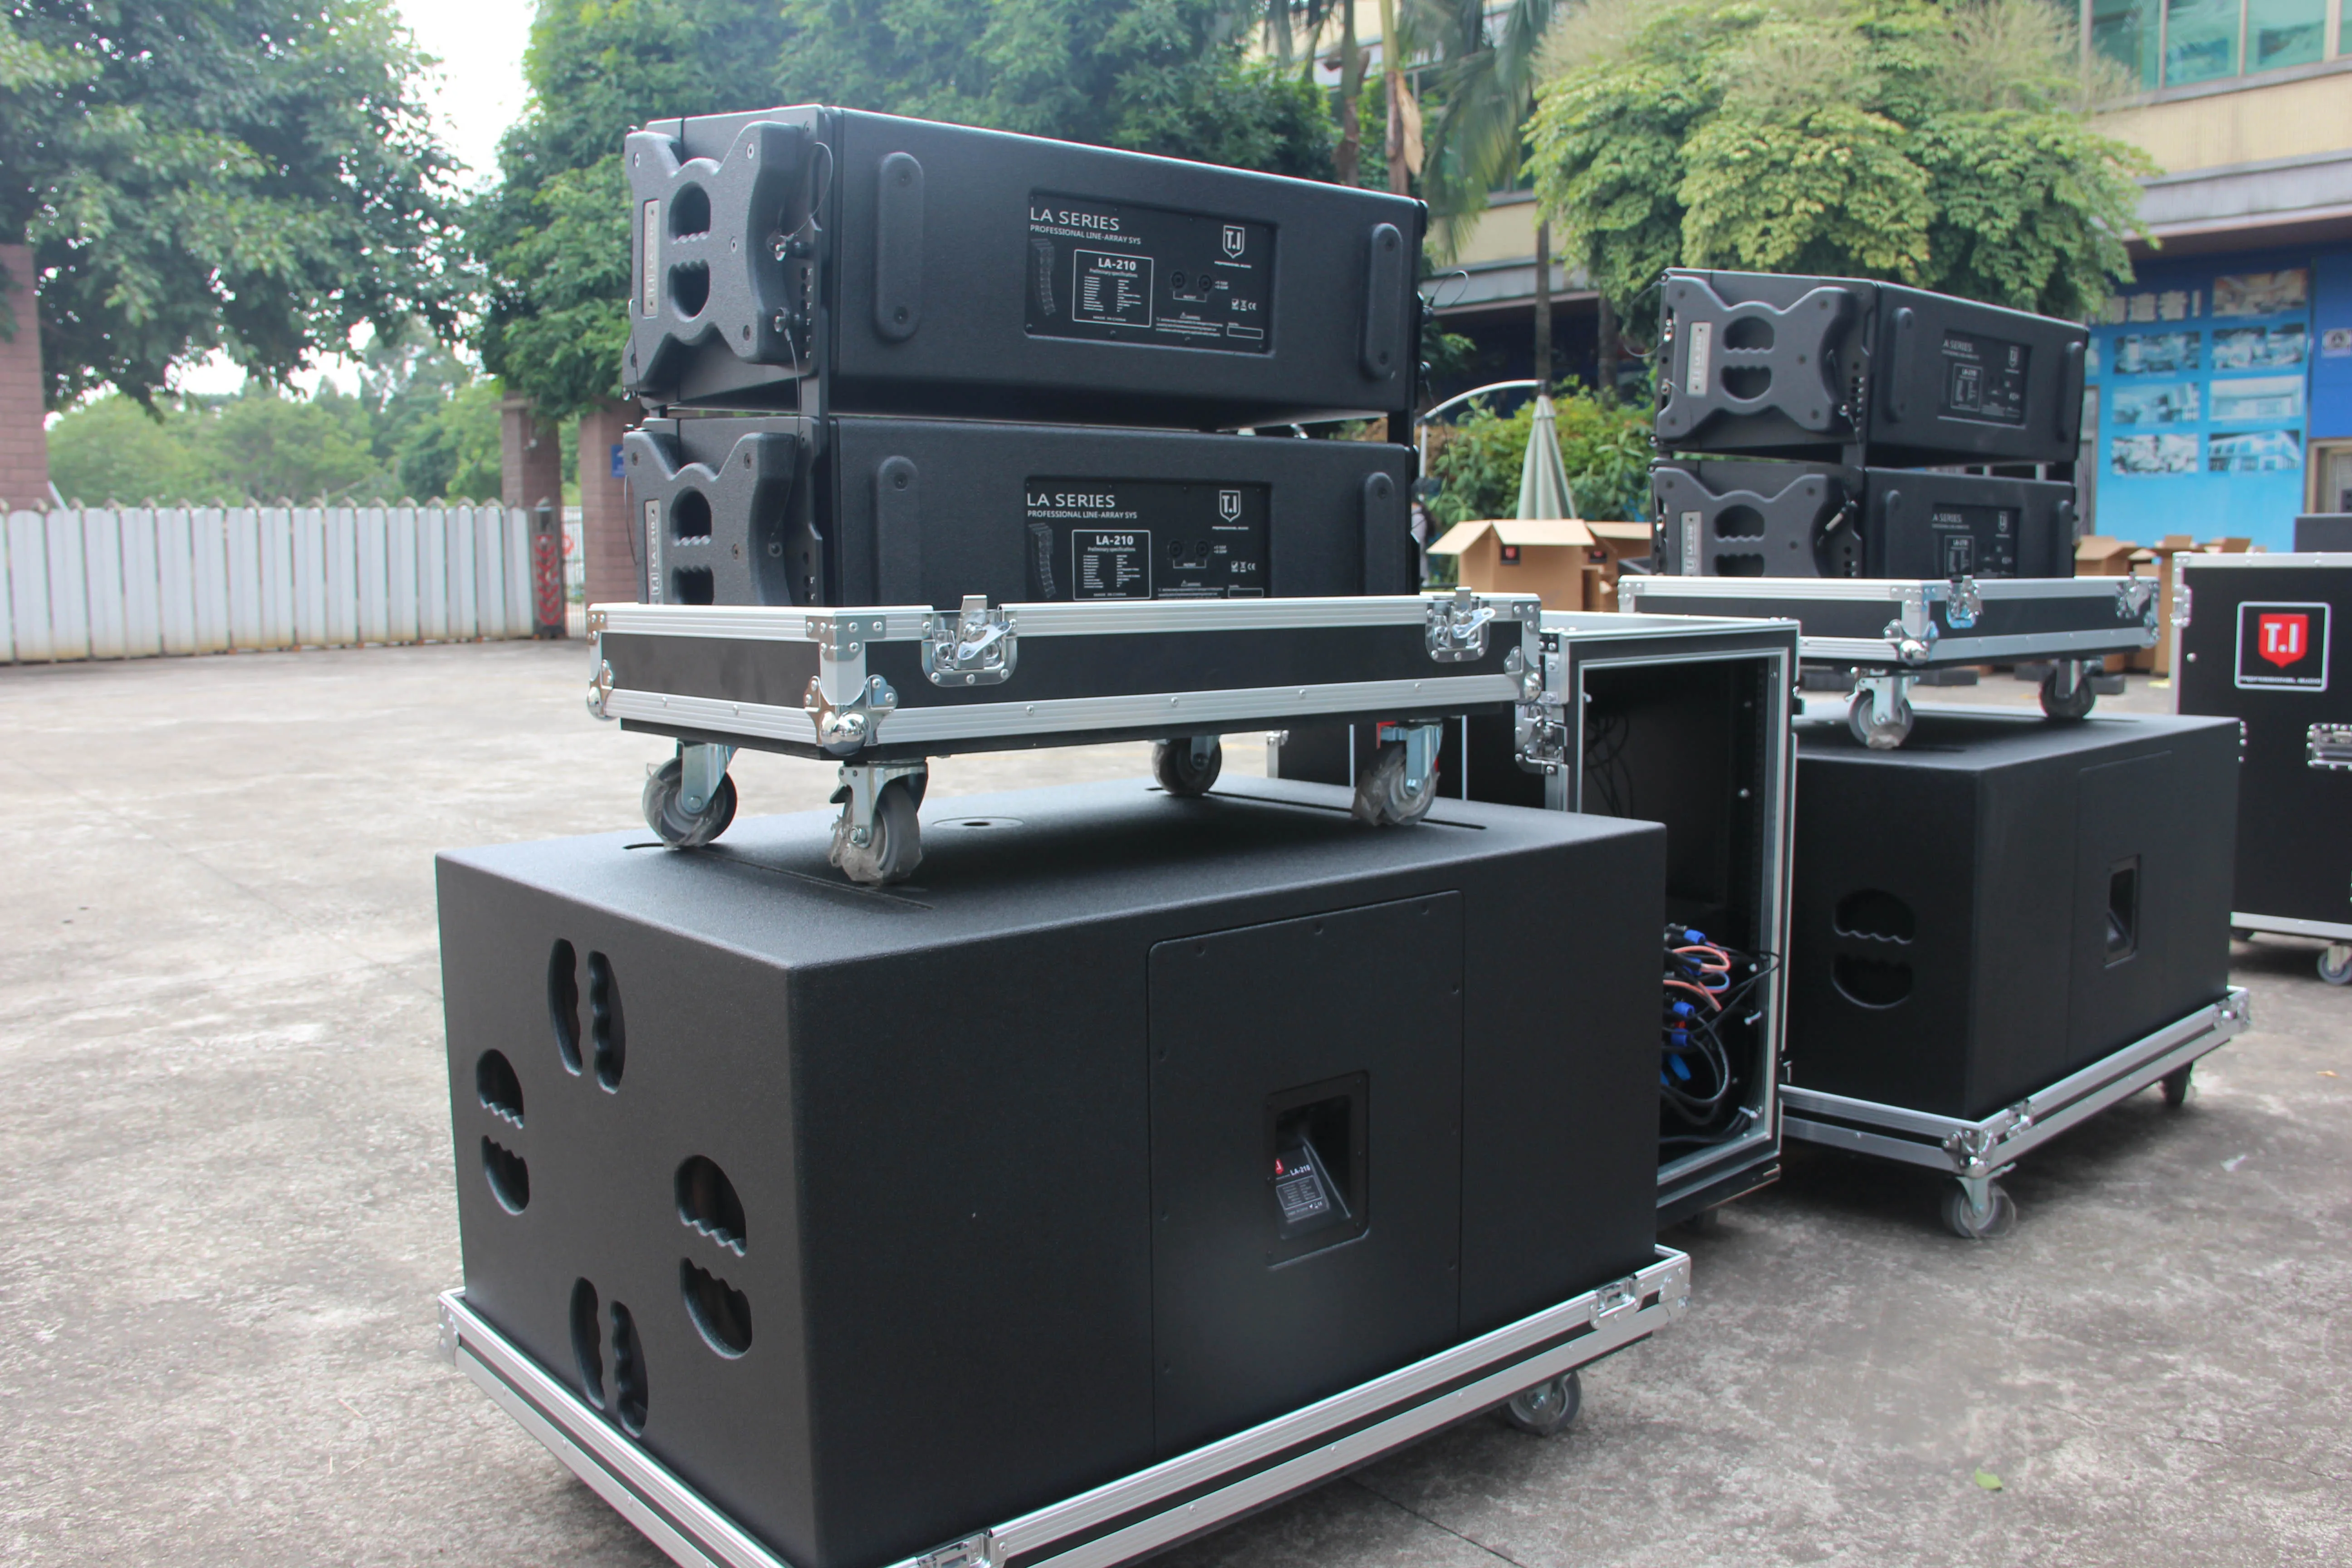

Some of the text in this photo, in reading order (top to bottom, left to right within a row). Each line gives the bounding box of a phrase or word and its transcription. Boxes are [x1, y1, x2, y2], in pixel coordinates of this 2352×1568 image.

[1030, 207, 1120, 231] LA SERIES
[1030, 224, 1085, 238] PROFESSIONAL
[1086, 232, 1128, 243] LINE-ARRAY
[1098, 257, 1137, 271] LA-210
[1027, 493, 1115, 508] LA SERIES
[1028, 510, 1081, 518] PROFESSIONAL
[1096, 535, 1134, 545] LA-210
[2264, 622, 2298, 653] T.I
